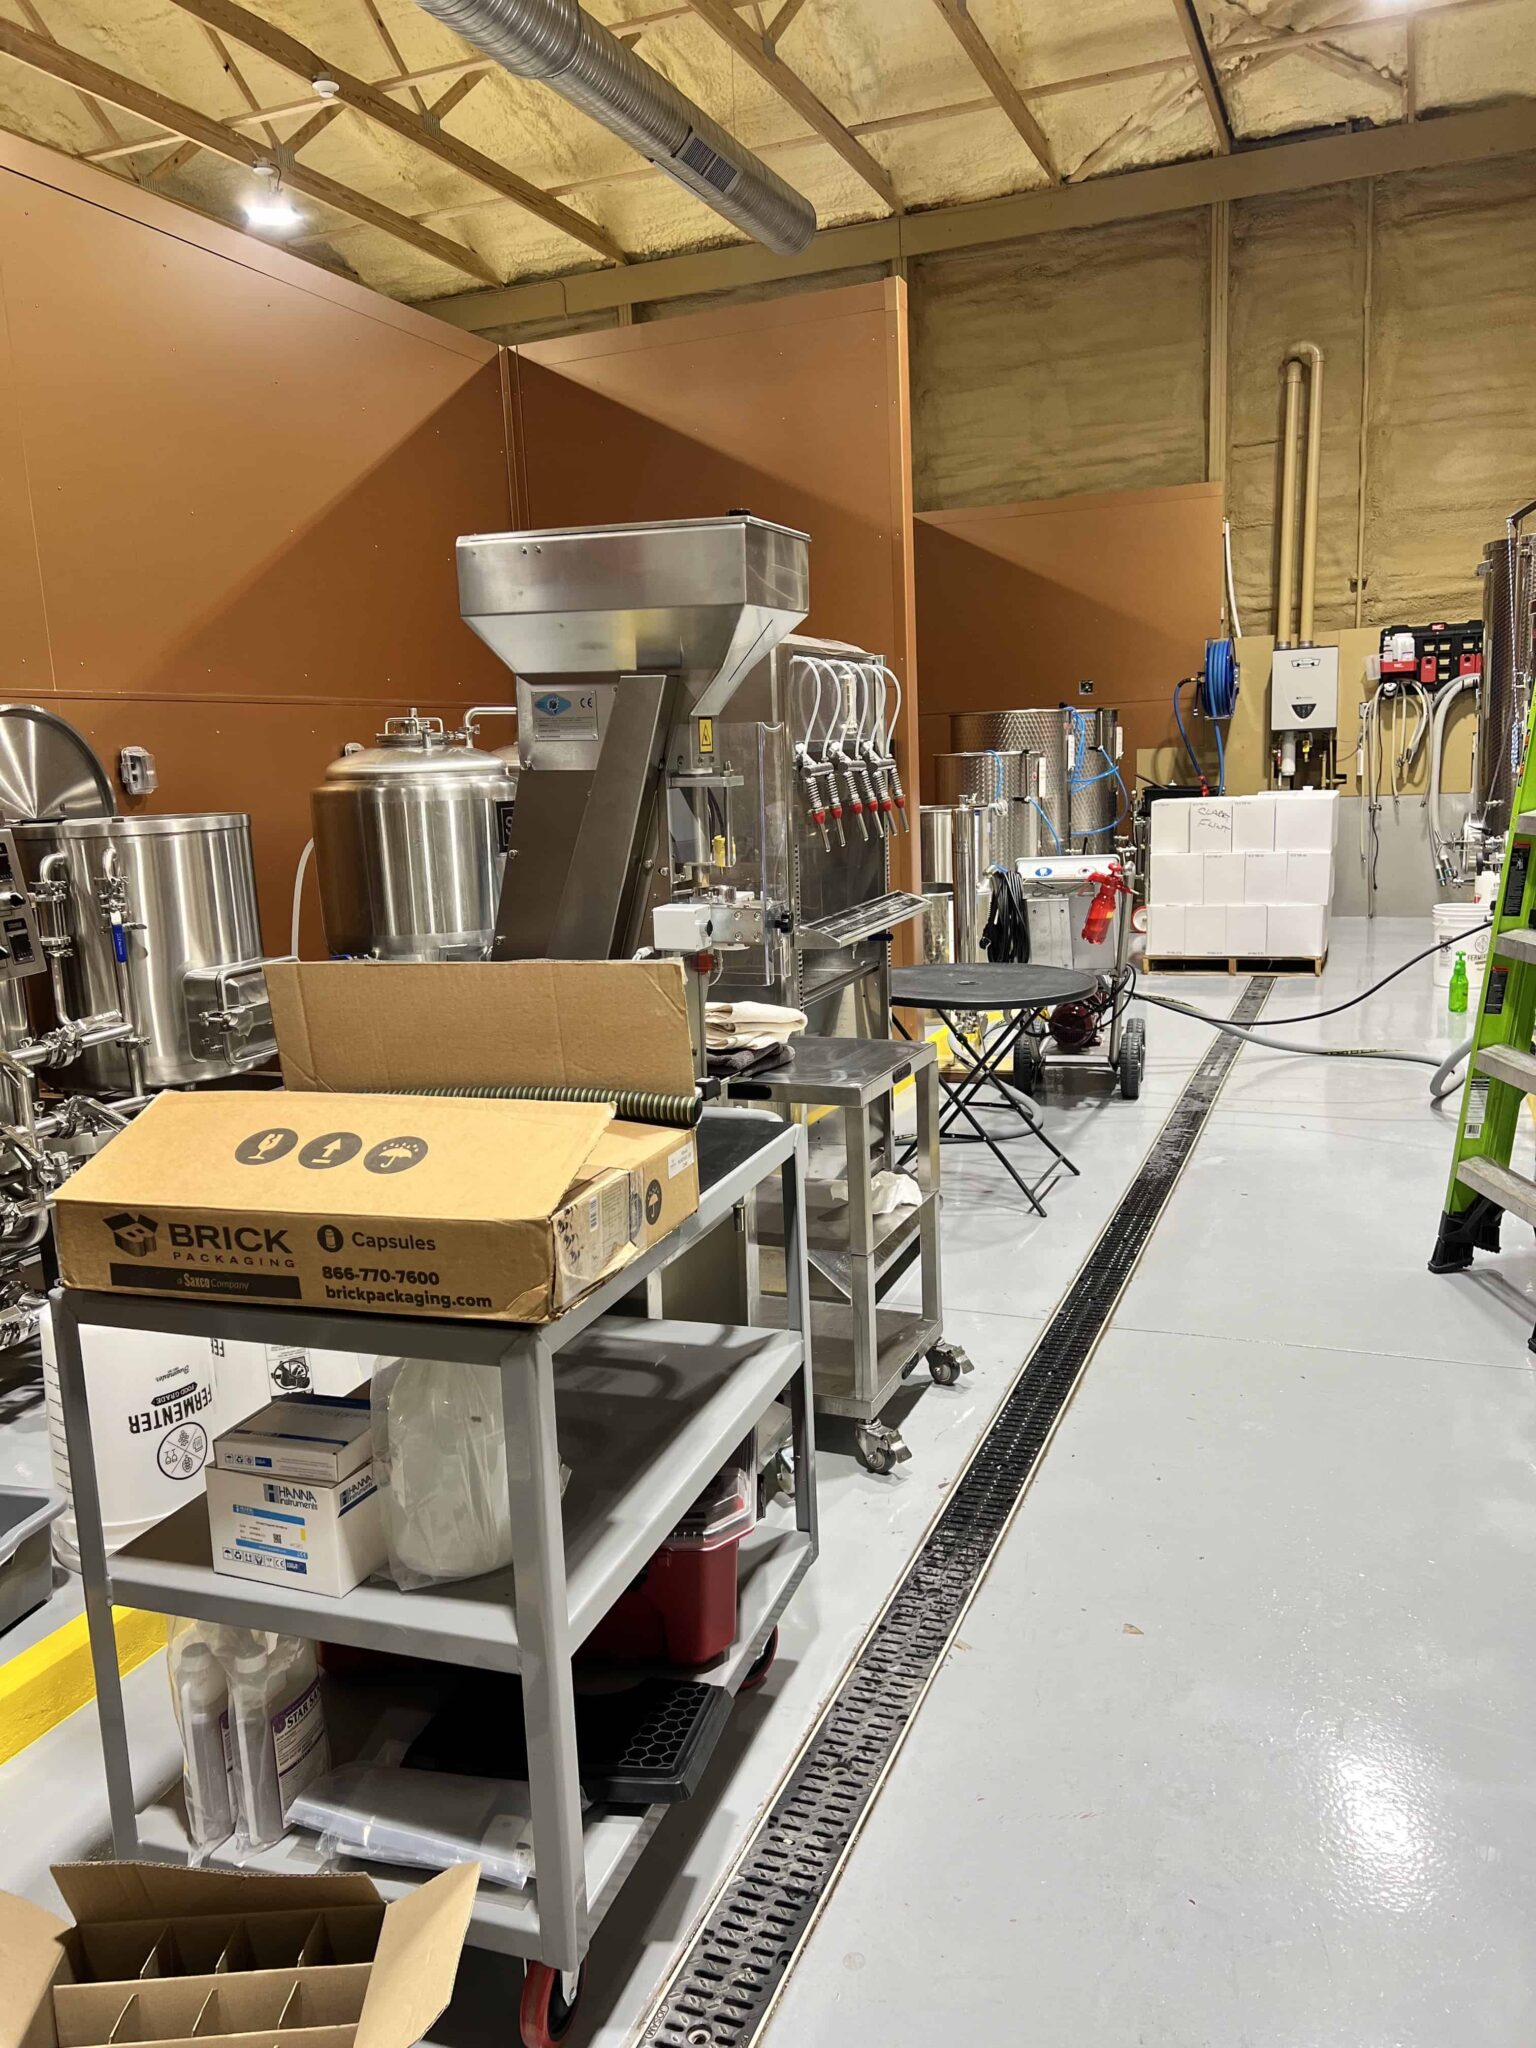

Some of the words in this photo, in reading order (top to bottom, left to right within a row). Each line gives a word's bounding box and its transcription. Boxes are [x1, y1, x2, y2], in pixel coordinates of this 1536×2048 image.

[168, 1223, 293, 1254] BRICK
[352, 1231, 436, 1252] Capsules
[173, 1251, 295, 1268] PACKAGING
[183, 1272, 210, 1288] Saxco
[210, 1278, 249, 1291] Company
[321, 1265, 440, 1286] 866-770-7600
[325, 1285, 493, 1309] brickpackaging.com
[156, 1389, 181, 1405] GRADE
[181, 1383, 196, 1397] FOOD
[128, 1384, 213, 1434] FERMENTER
[278, 1485, 317, 1503] HANNA
[286, 1700, 309, 1729] STAR
